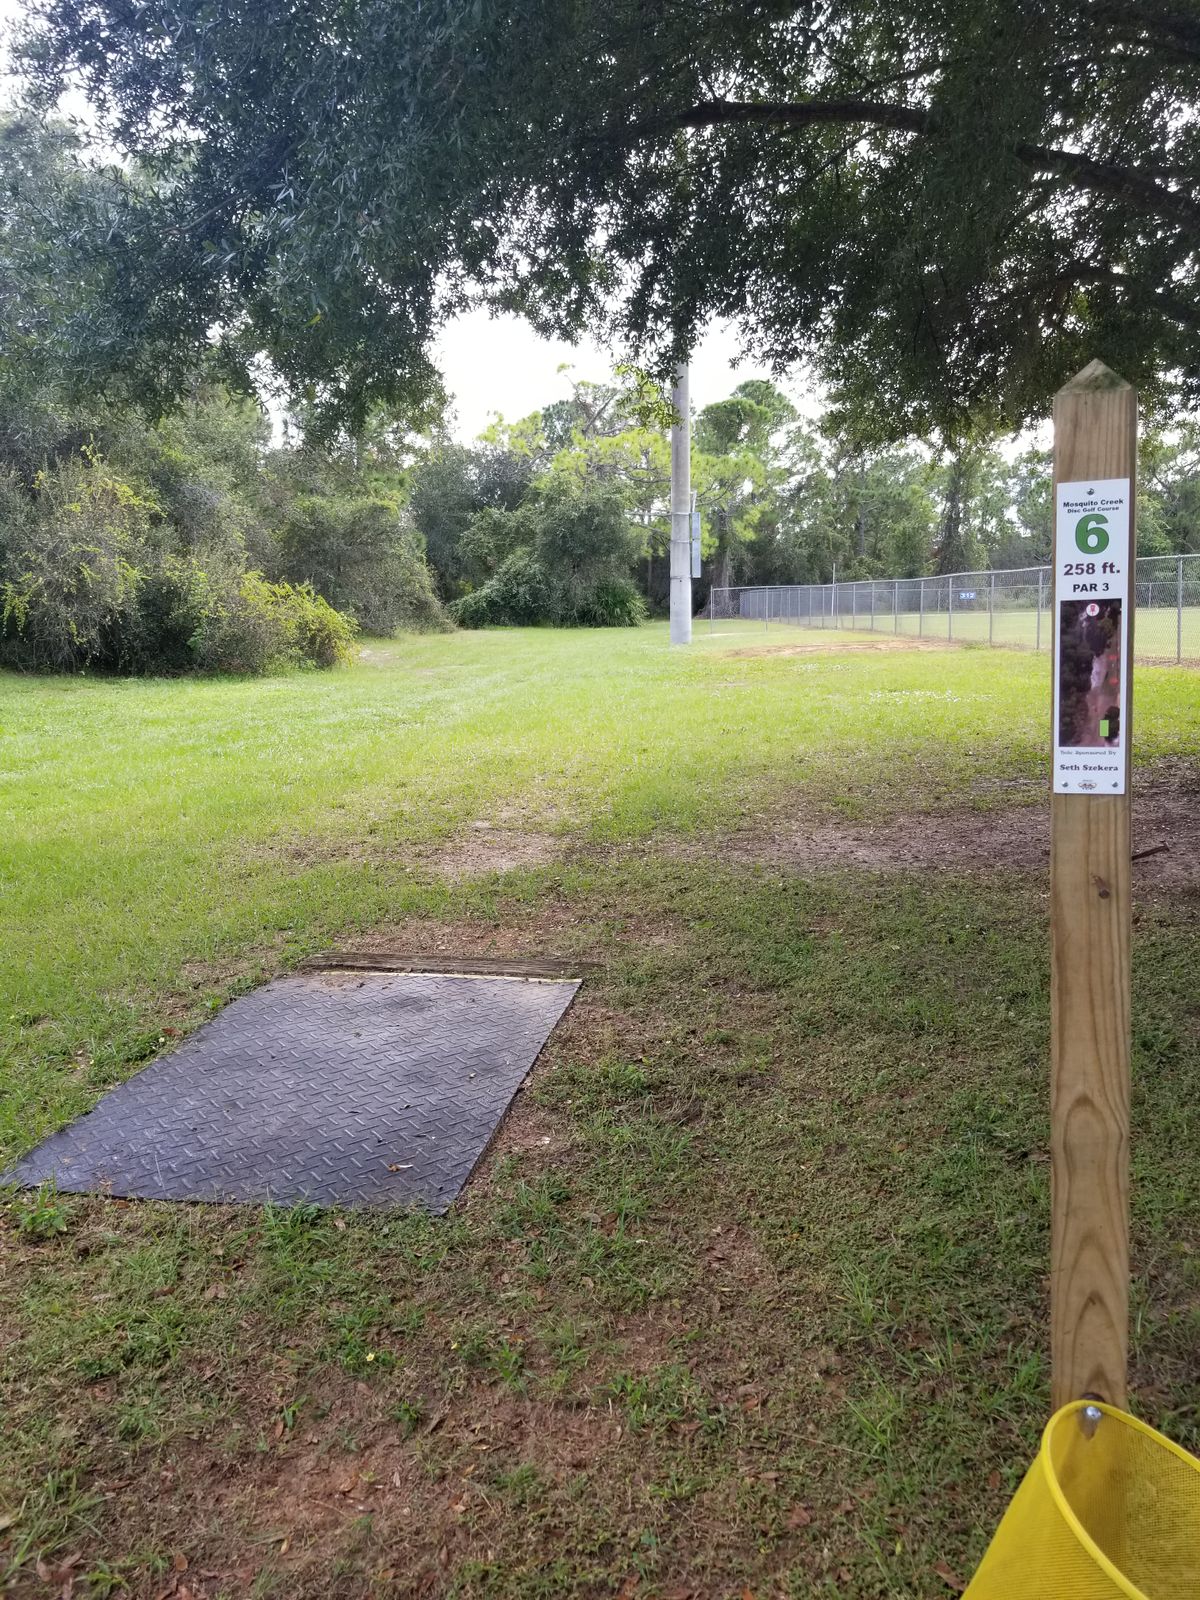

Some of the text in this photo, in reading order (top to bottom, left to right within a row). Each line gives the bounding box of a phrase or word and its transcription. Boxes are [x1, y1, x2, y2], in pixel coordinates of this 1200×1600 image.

[1063, 498, 1124, 508] Mosquito Creek
[1075, 513, 1110, 555] 6
[1063, 562, 1121, 576] 258 ft.
[1072, 582, 1110, 593] PAR 3
